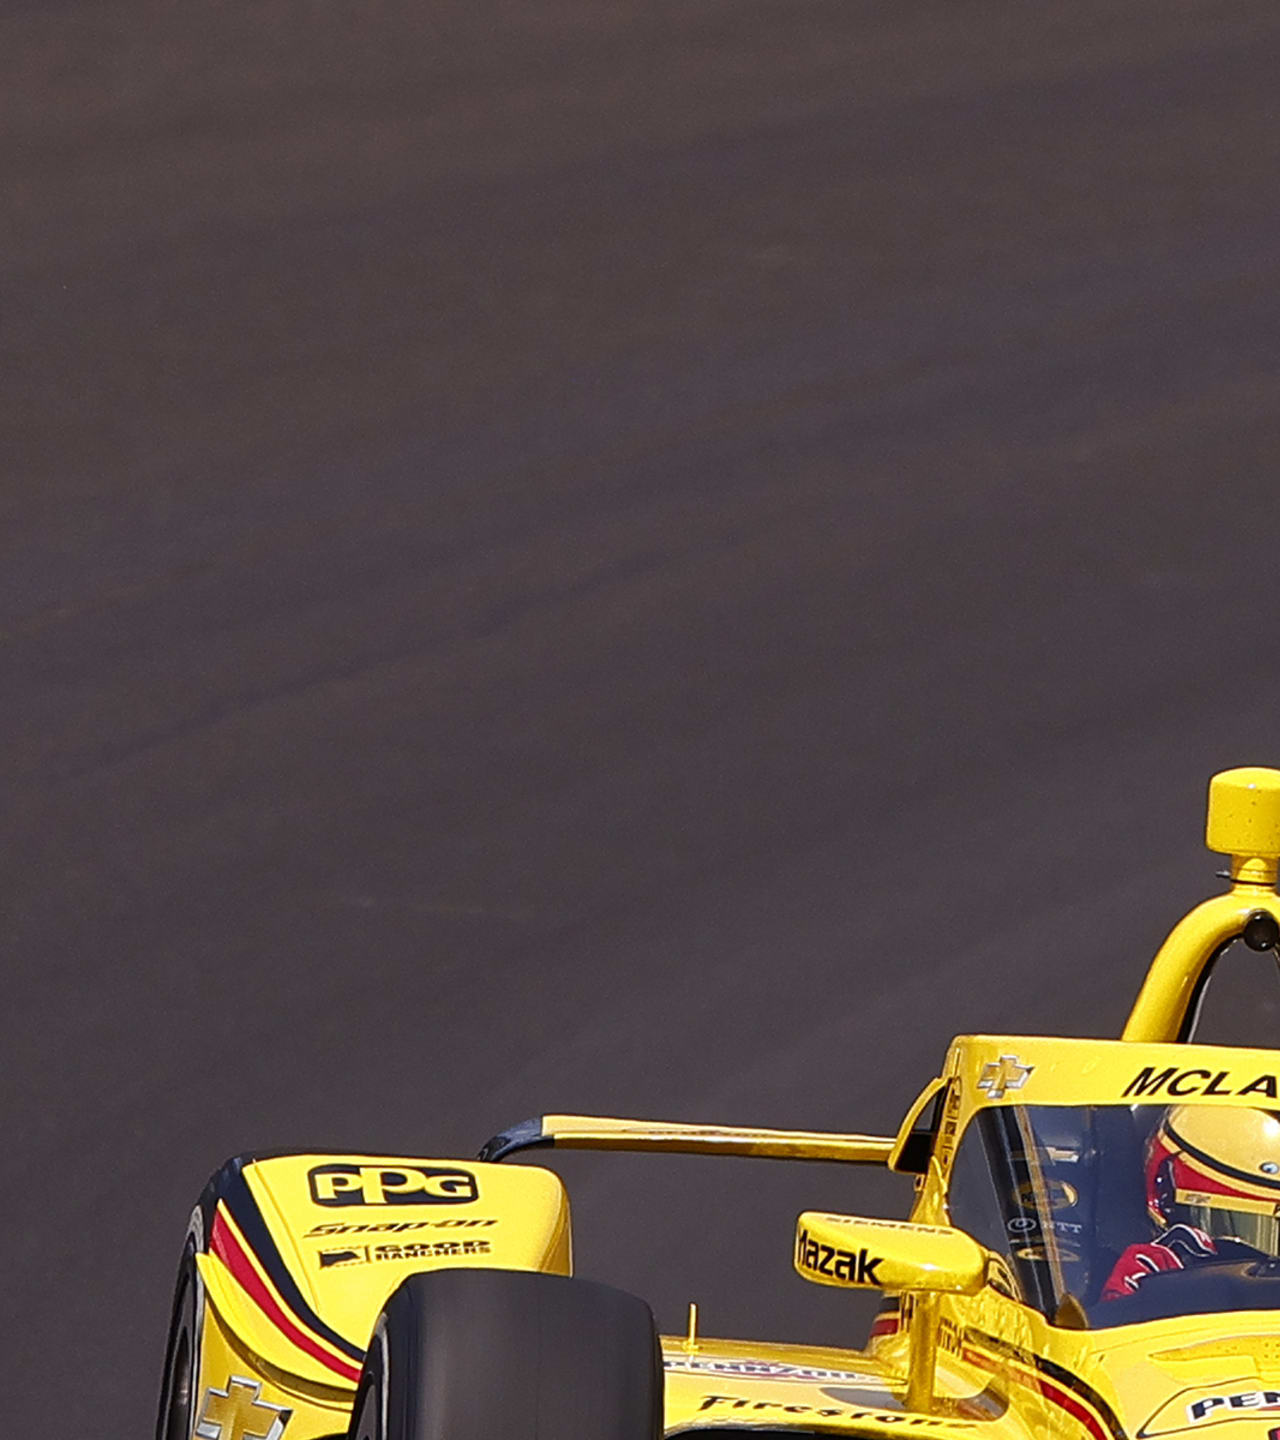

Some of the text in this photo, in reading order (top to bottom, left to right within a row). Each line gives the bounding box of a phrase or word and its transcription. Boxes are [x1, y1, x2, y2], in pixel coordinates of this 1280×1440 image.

[313, 1166, 474, 1204] PPG
[302, 1219, 499, 1239] Snap-on
[374, 1240, 491, 1252] GOOD
